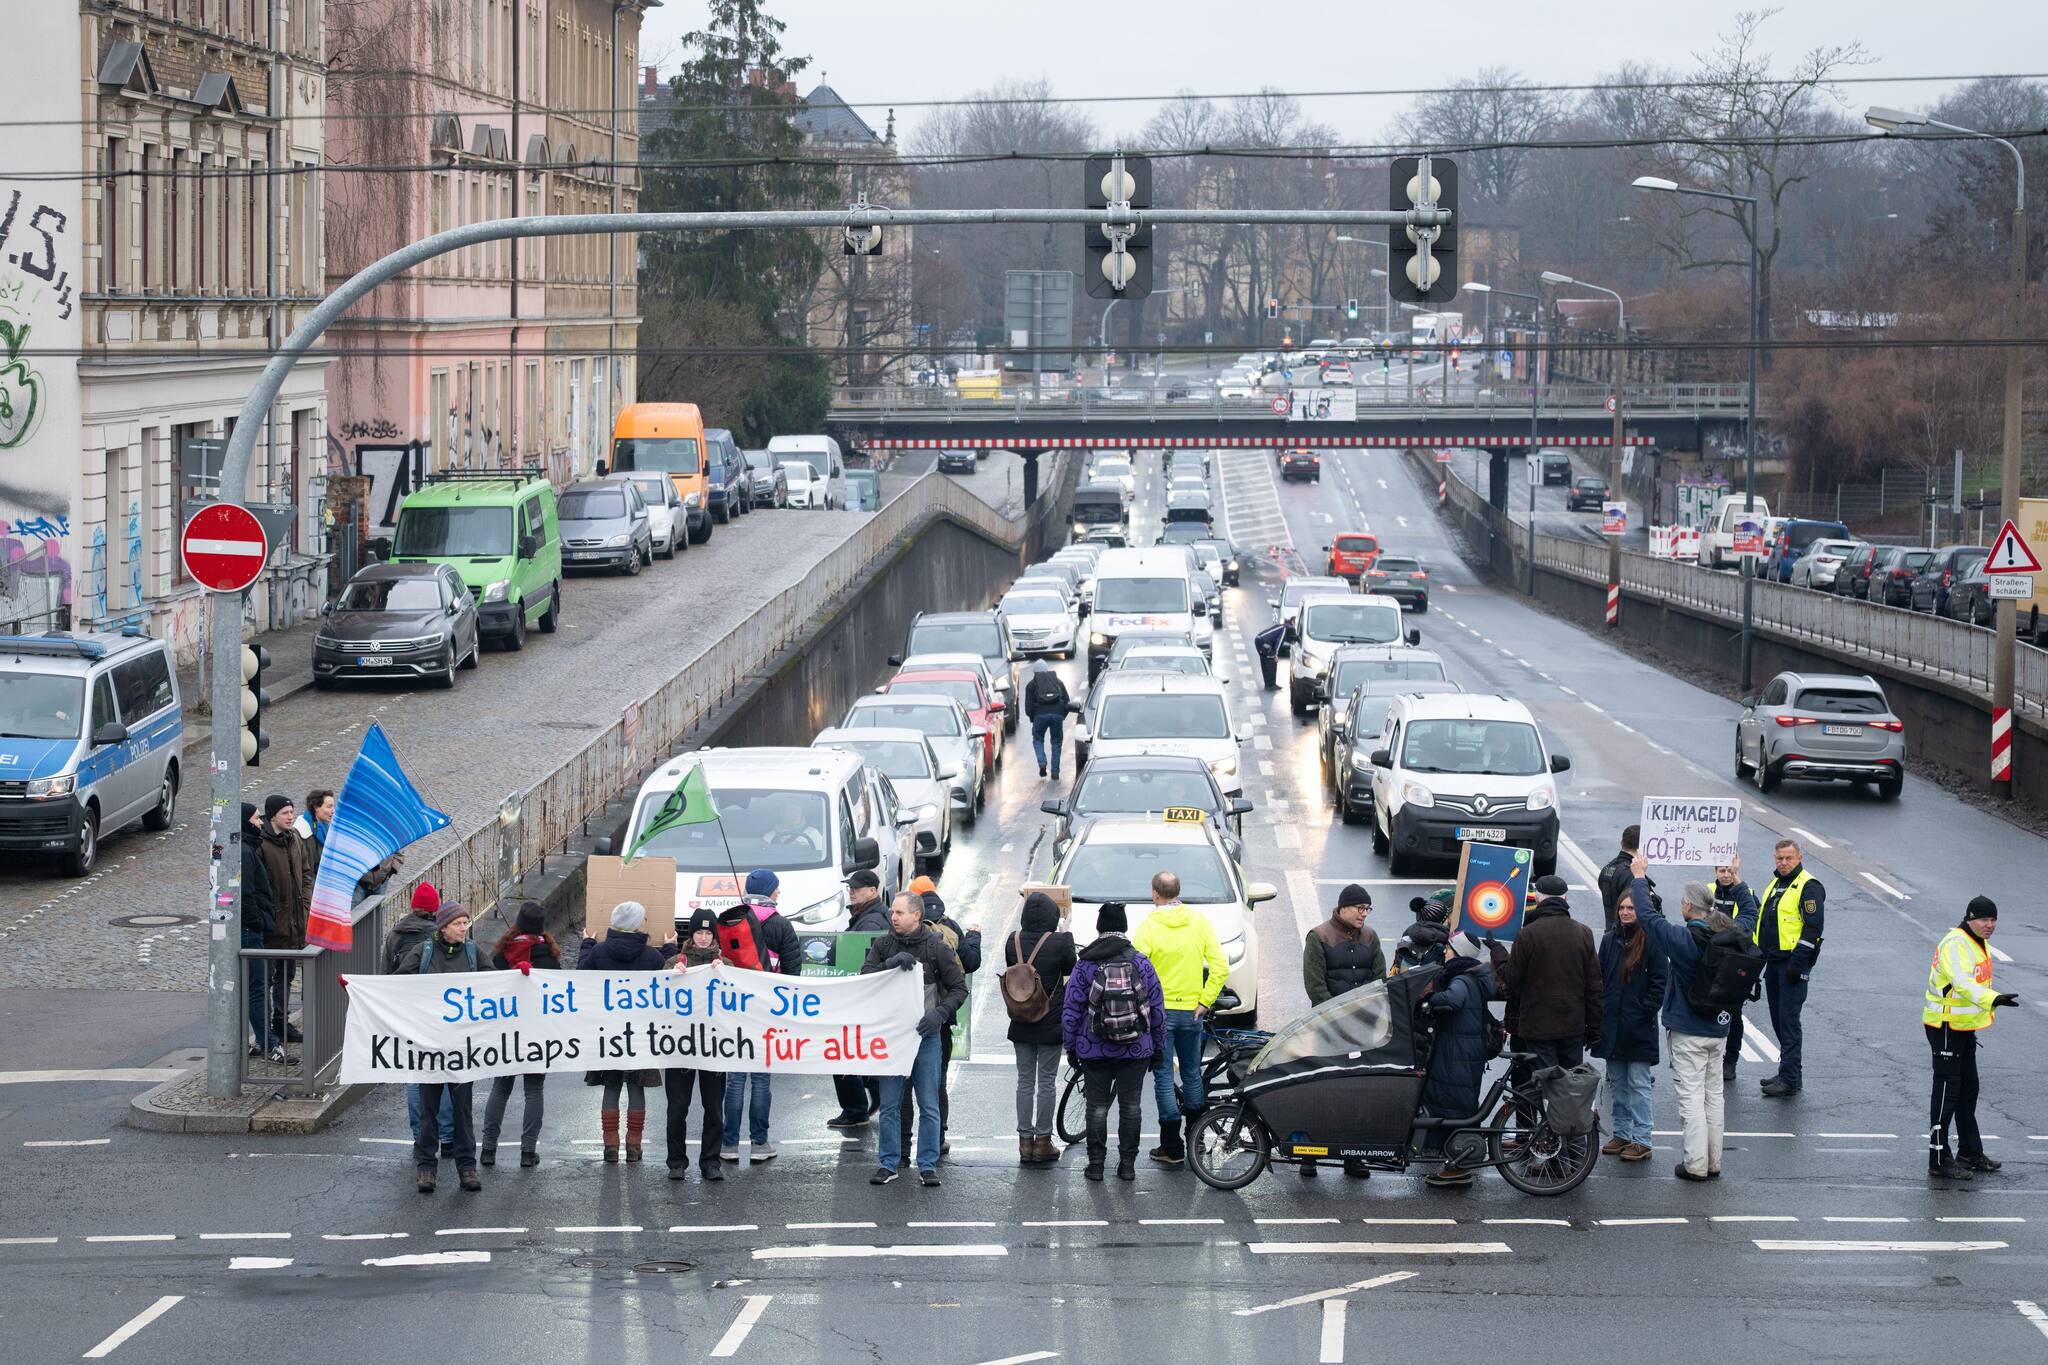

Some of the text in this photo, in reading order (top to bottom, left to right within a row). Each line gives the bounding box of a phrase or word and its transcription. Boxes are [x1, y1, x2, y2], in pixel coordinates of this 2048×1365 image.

[1995, 578, 2028, 586] Straßen-
[1995, 587, 2027, 595] schäden
[1108, 616, 1170, 626] FedEx
[130, 737, 150, 761] POLIZEI
[1170, 809, 1197, 820] TAXI
[1651, 804, 1738, 823] KLIMAGELD
[1461, 828, 1505, 839] DD MM 4328
[1663, 823, 1717, 834] jetzt und
[1709, 842, 1737, 855] hoch!
[442, 976, 821, 1022] Stau ist lästig für Sie
[370, 1022, 889, 1071] Klimakollaps ist tödlich für alle
